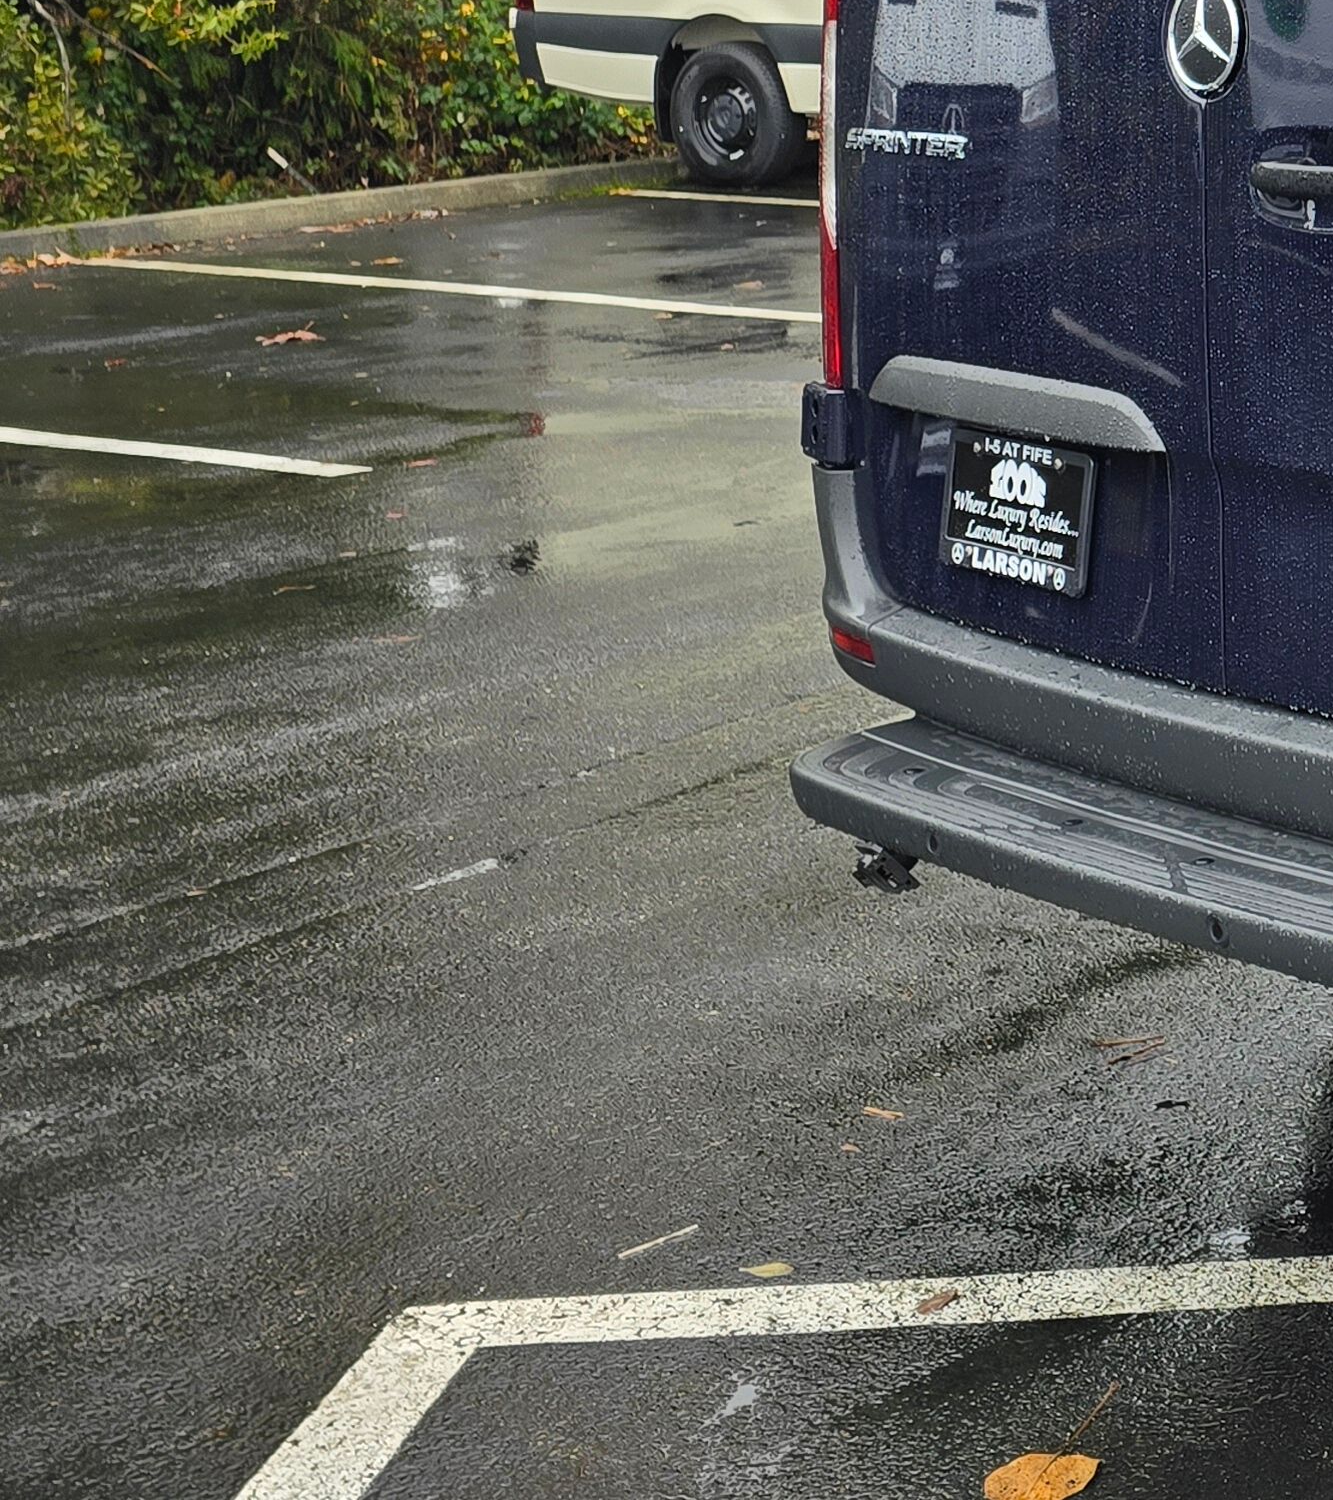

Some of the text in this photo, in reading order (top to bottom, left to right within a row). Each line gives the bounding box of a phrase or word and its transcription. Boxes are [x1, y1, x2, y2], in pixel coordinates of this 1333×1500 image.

[845, 127, 968, 160] SPRINTER
[985, 437, 1052, 466] I-5 AT FIFE
[953, 490, 988, 516] Where
[988, 499, 1028, 532] Luxury
[965, 519, 1064, 559] LarsonLuxury.com
